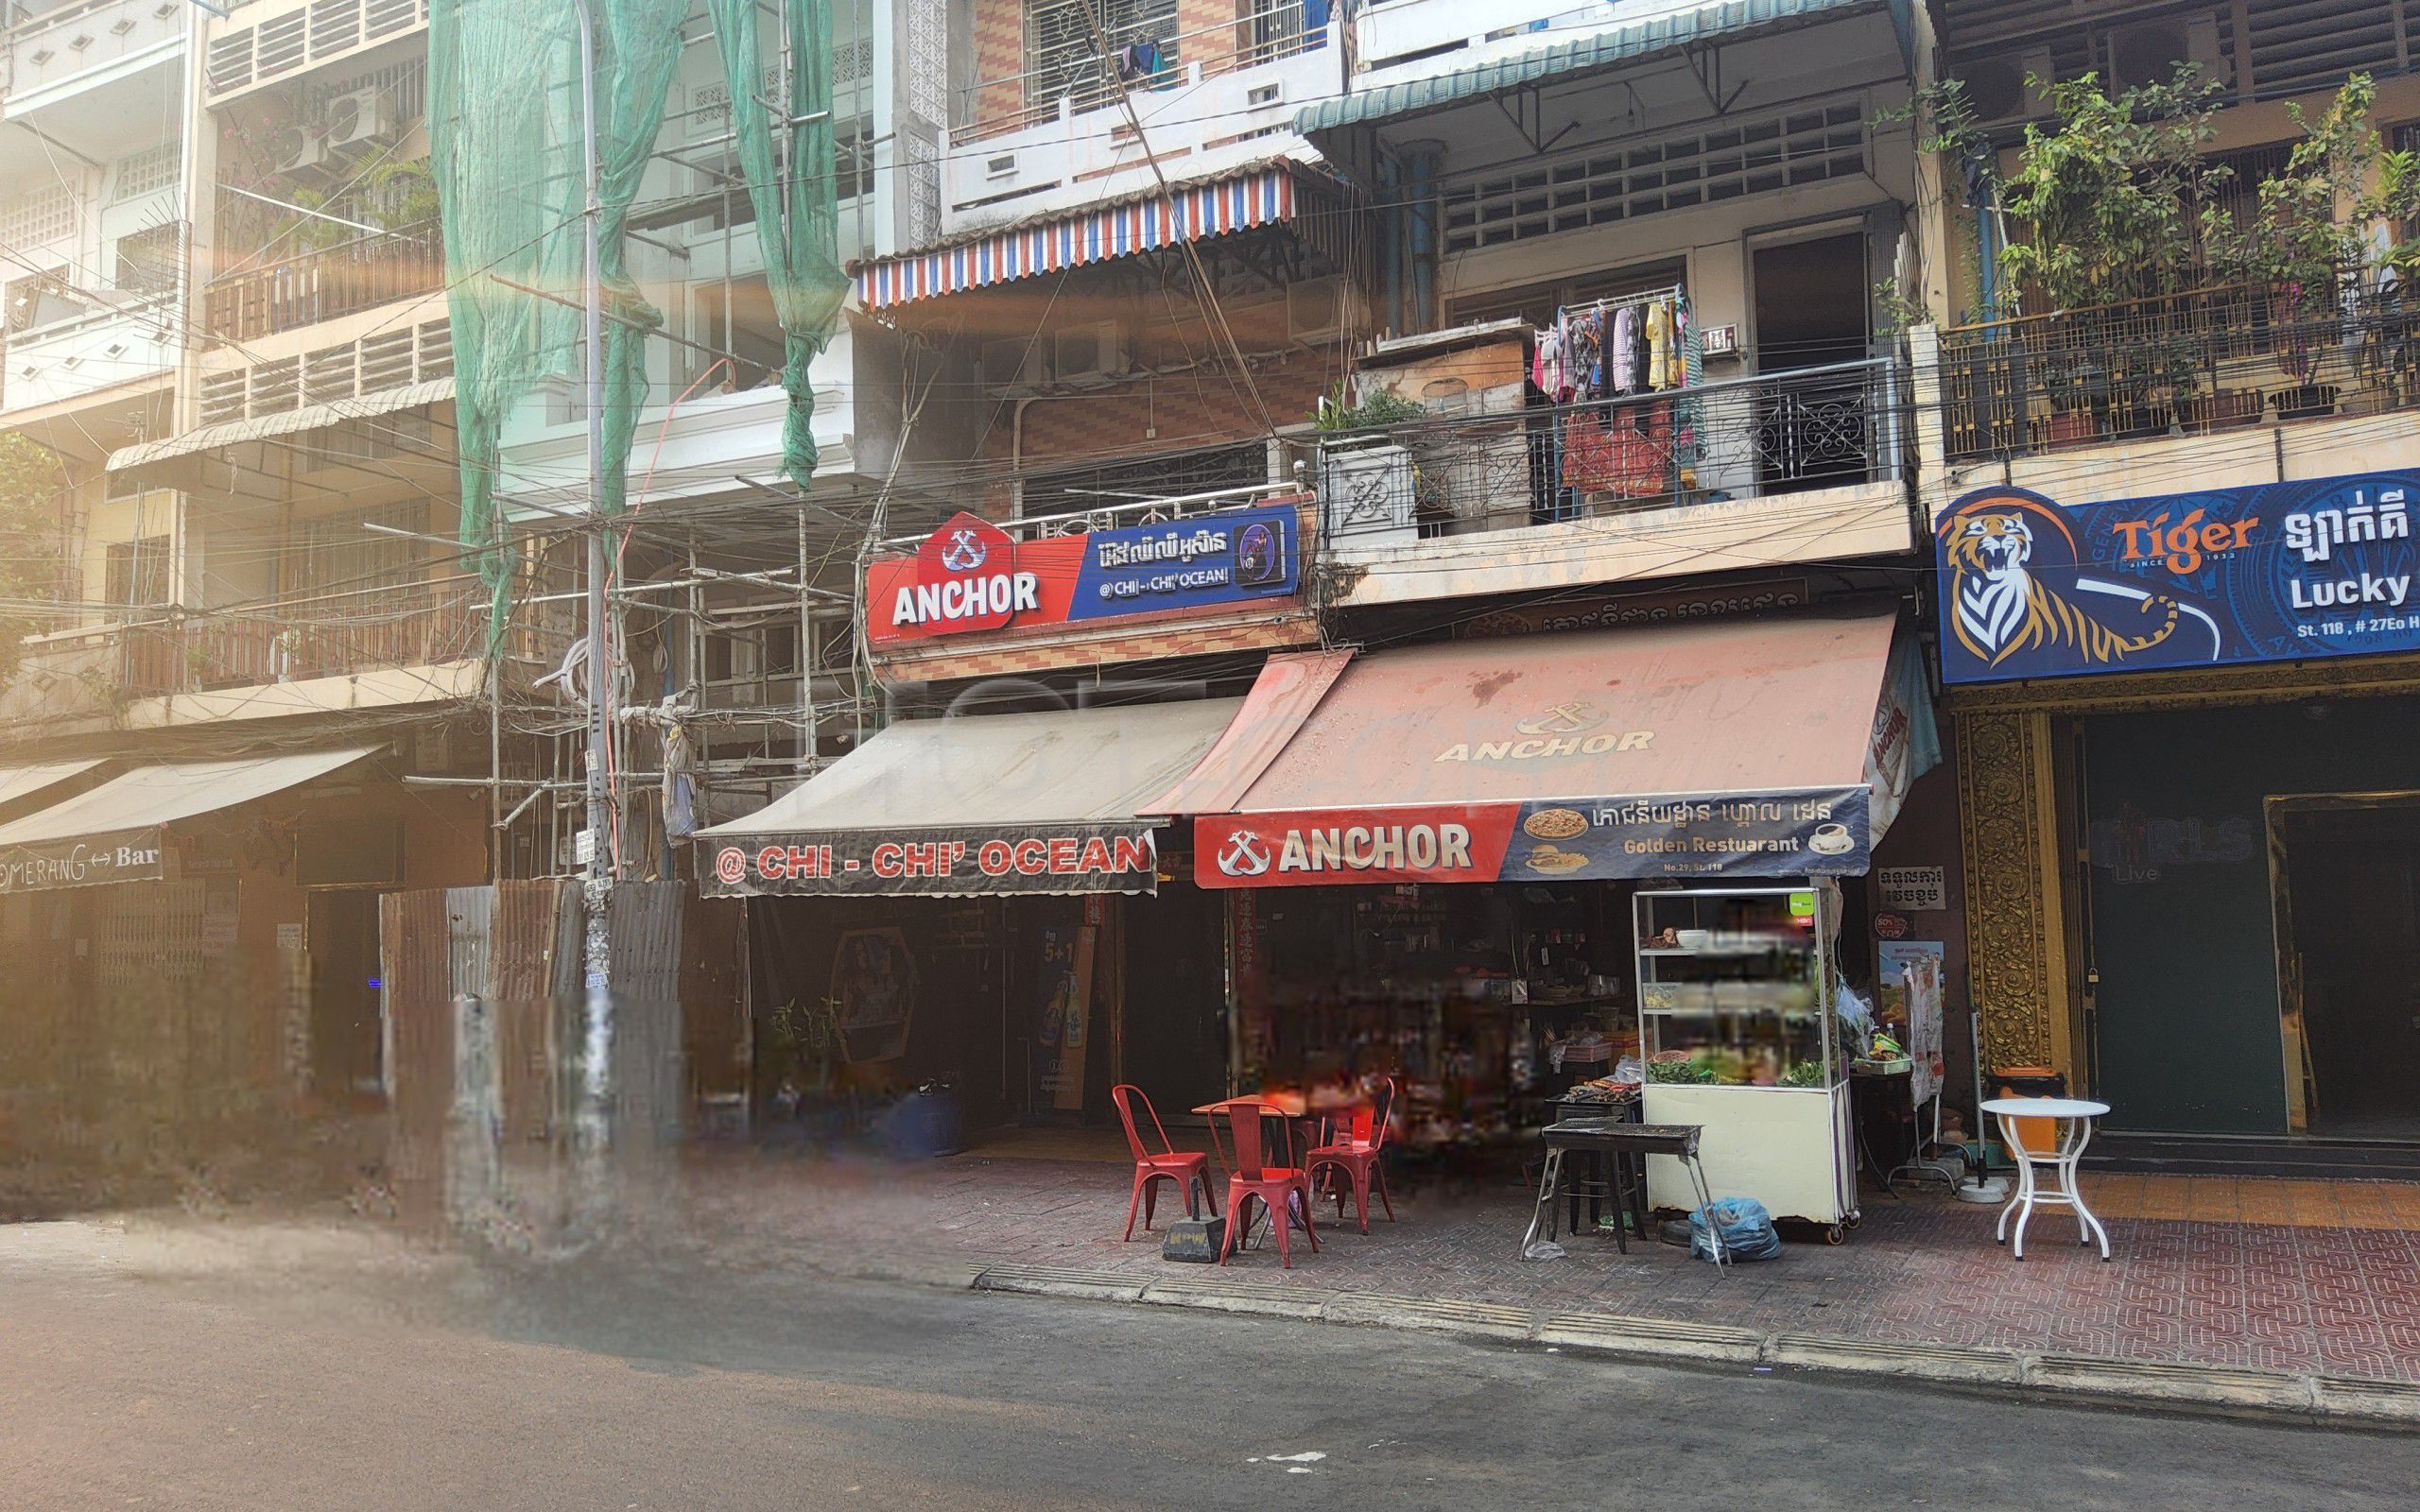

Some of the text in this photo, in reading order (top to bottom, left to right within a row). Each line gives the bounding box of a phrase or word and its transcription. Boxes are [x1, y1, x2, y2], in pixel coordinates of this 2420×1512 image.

[2112, 508, 2259, 575] Tiger
[2130, 553, 2237, 568] SINCE 1932
[892, 573, 1039, 626] ANCHOR
[1099, 583, 1114, 599] @
[1179, 567, 1229, 588] OCEAN
[2290, 573, 2411, 609] Lucky
[2297, 625, 2318, 638] St.
[2322, 622, 2343, 635] 118
[2370, 618, 2405, 631] 27Eo
[1434, 730, 1656, 764] ANCHOR
[115, 847, 159, 868] Bar
[717, 846, 747, 885] @
[756, 845, 833, 880] CHI
[872, 840, 965, 880] CHI'
[977, 835, 1153, 879] OCEAN
[1279, 824, 1472, 873] ANCHOR
[1624, 836, 1799, 854] Golden Restuarant
[1708, 863, 1722, 871] 118
